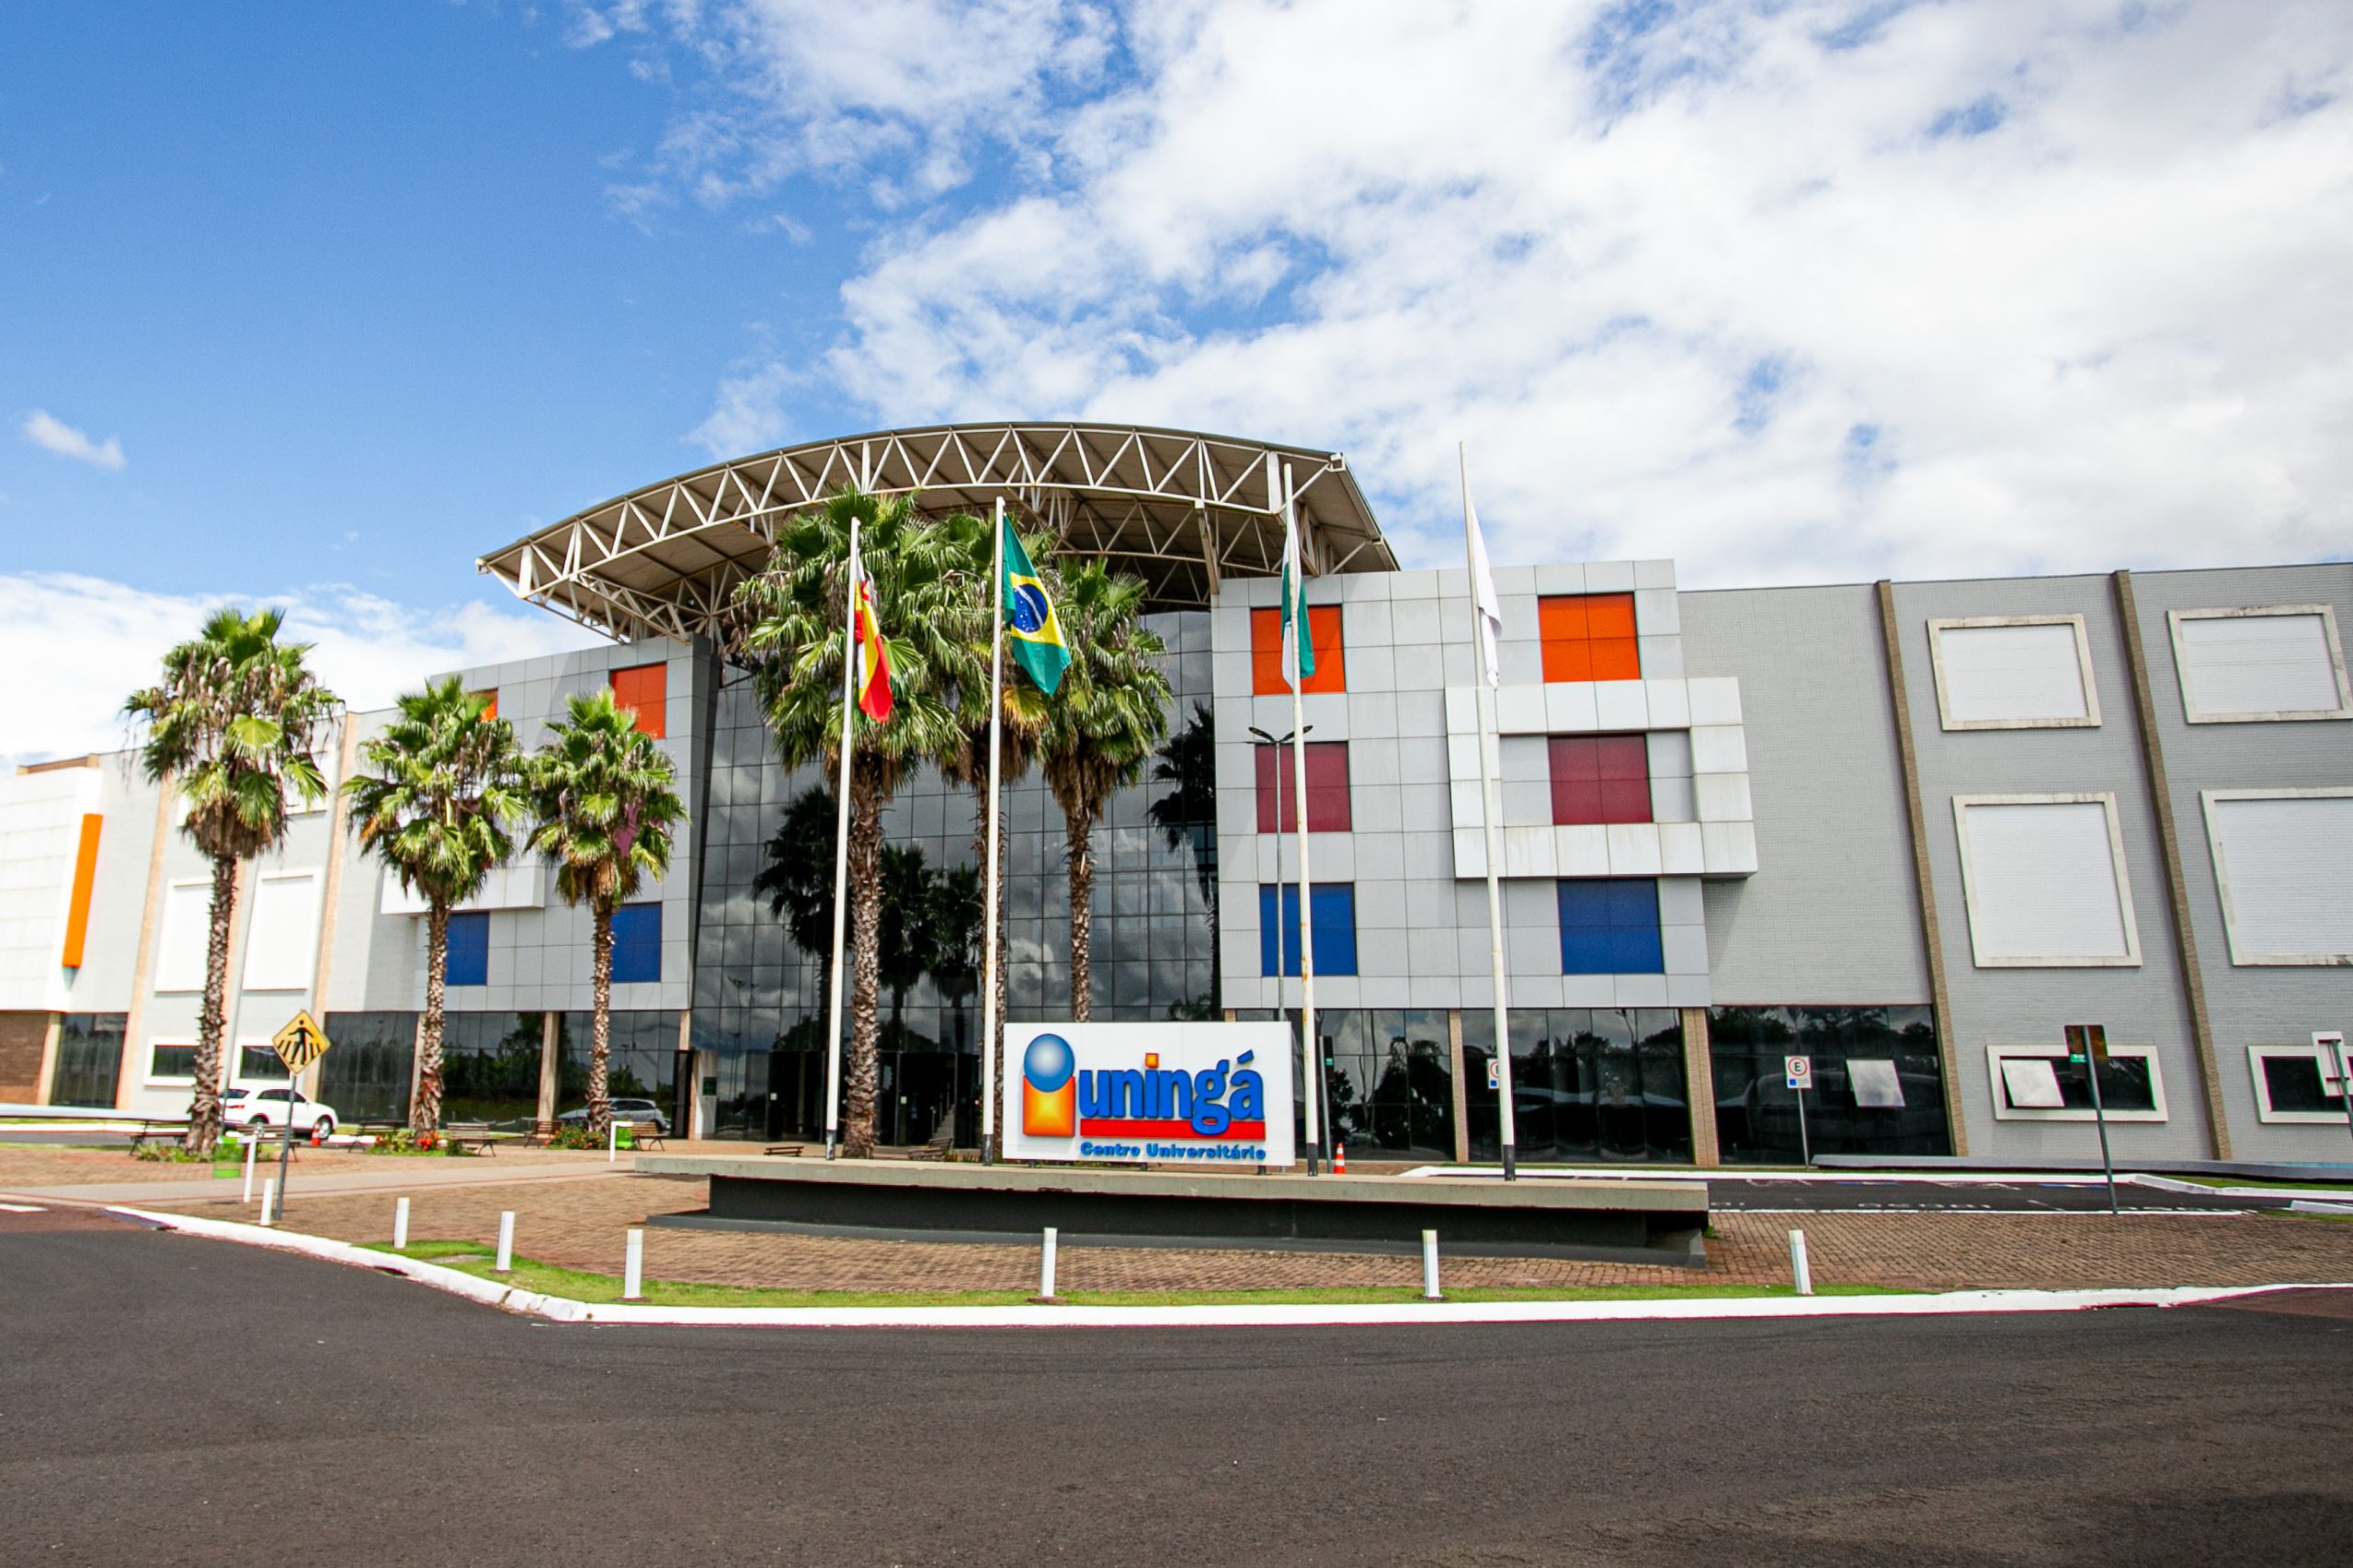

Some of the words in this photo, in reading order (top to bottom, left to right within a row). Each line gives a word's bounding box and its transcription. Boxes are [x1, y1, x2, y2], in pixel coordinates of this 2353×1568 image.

[1794, 1062, 1802, 1072] E
[1078, 1049, 1265, 1136] uningá
[1080, 1142, 1141, 1158] Centro
[1146, 1142, 1267, 1161] Universitário
